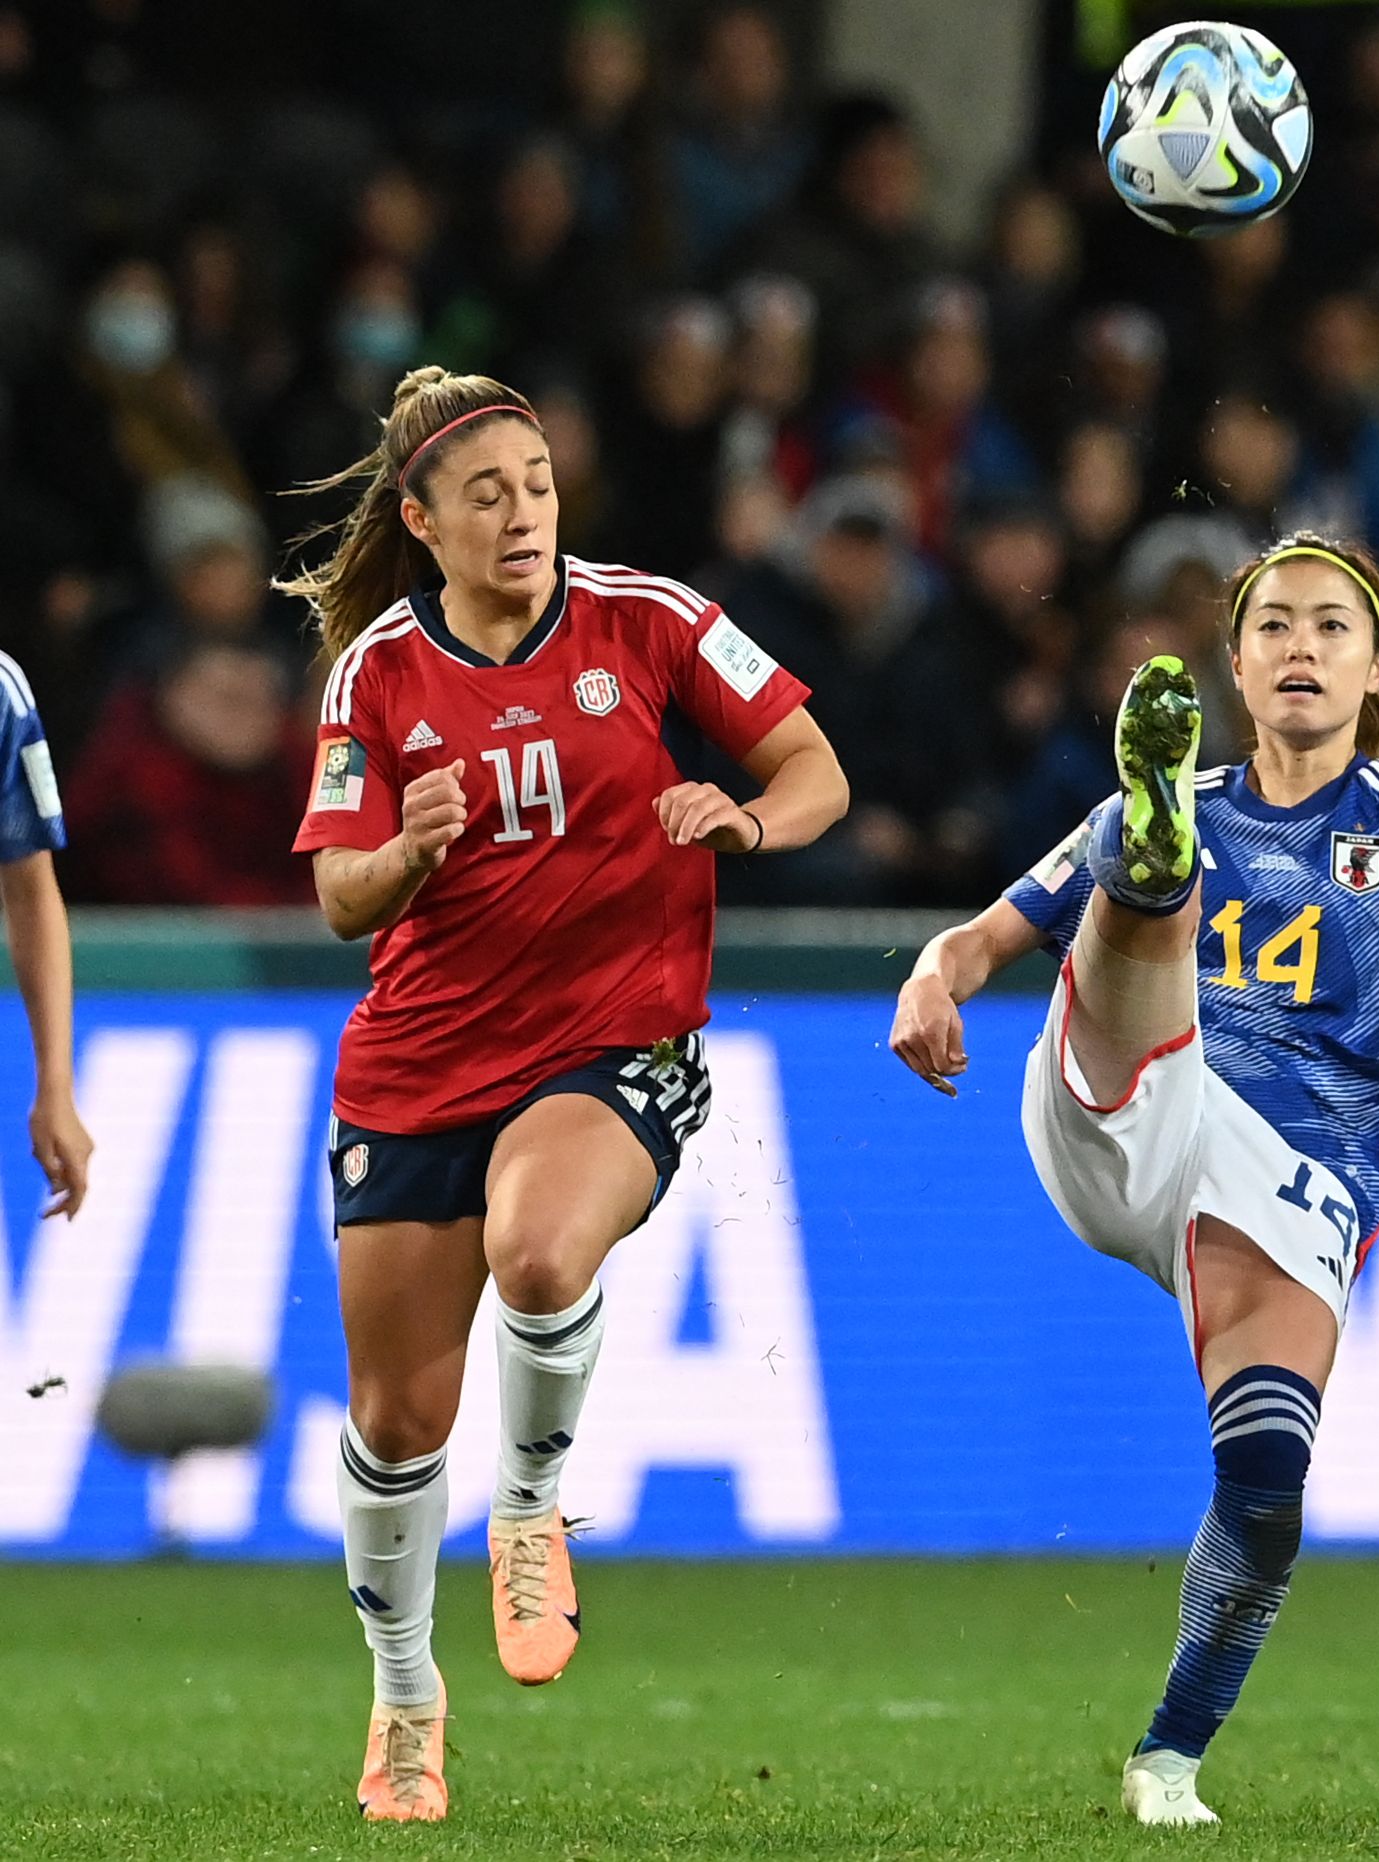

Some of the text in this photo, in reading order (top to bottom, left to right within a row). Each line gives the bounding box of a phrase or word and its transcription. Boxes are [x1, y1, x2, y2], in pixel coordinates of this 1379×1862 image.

[583, 677, 610, 707] CR
[402, 736, 443, 753] adidas
[481, 739, 565, 843] 14
[1207, 900, 1323, 1004] 14
[0, 1028, 842, 1545] VIA
